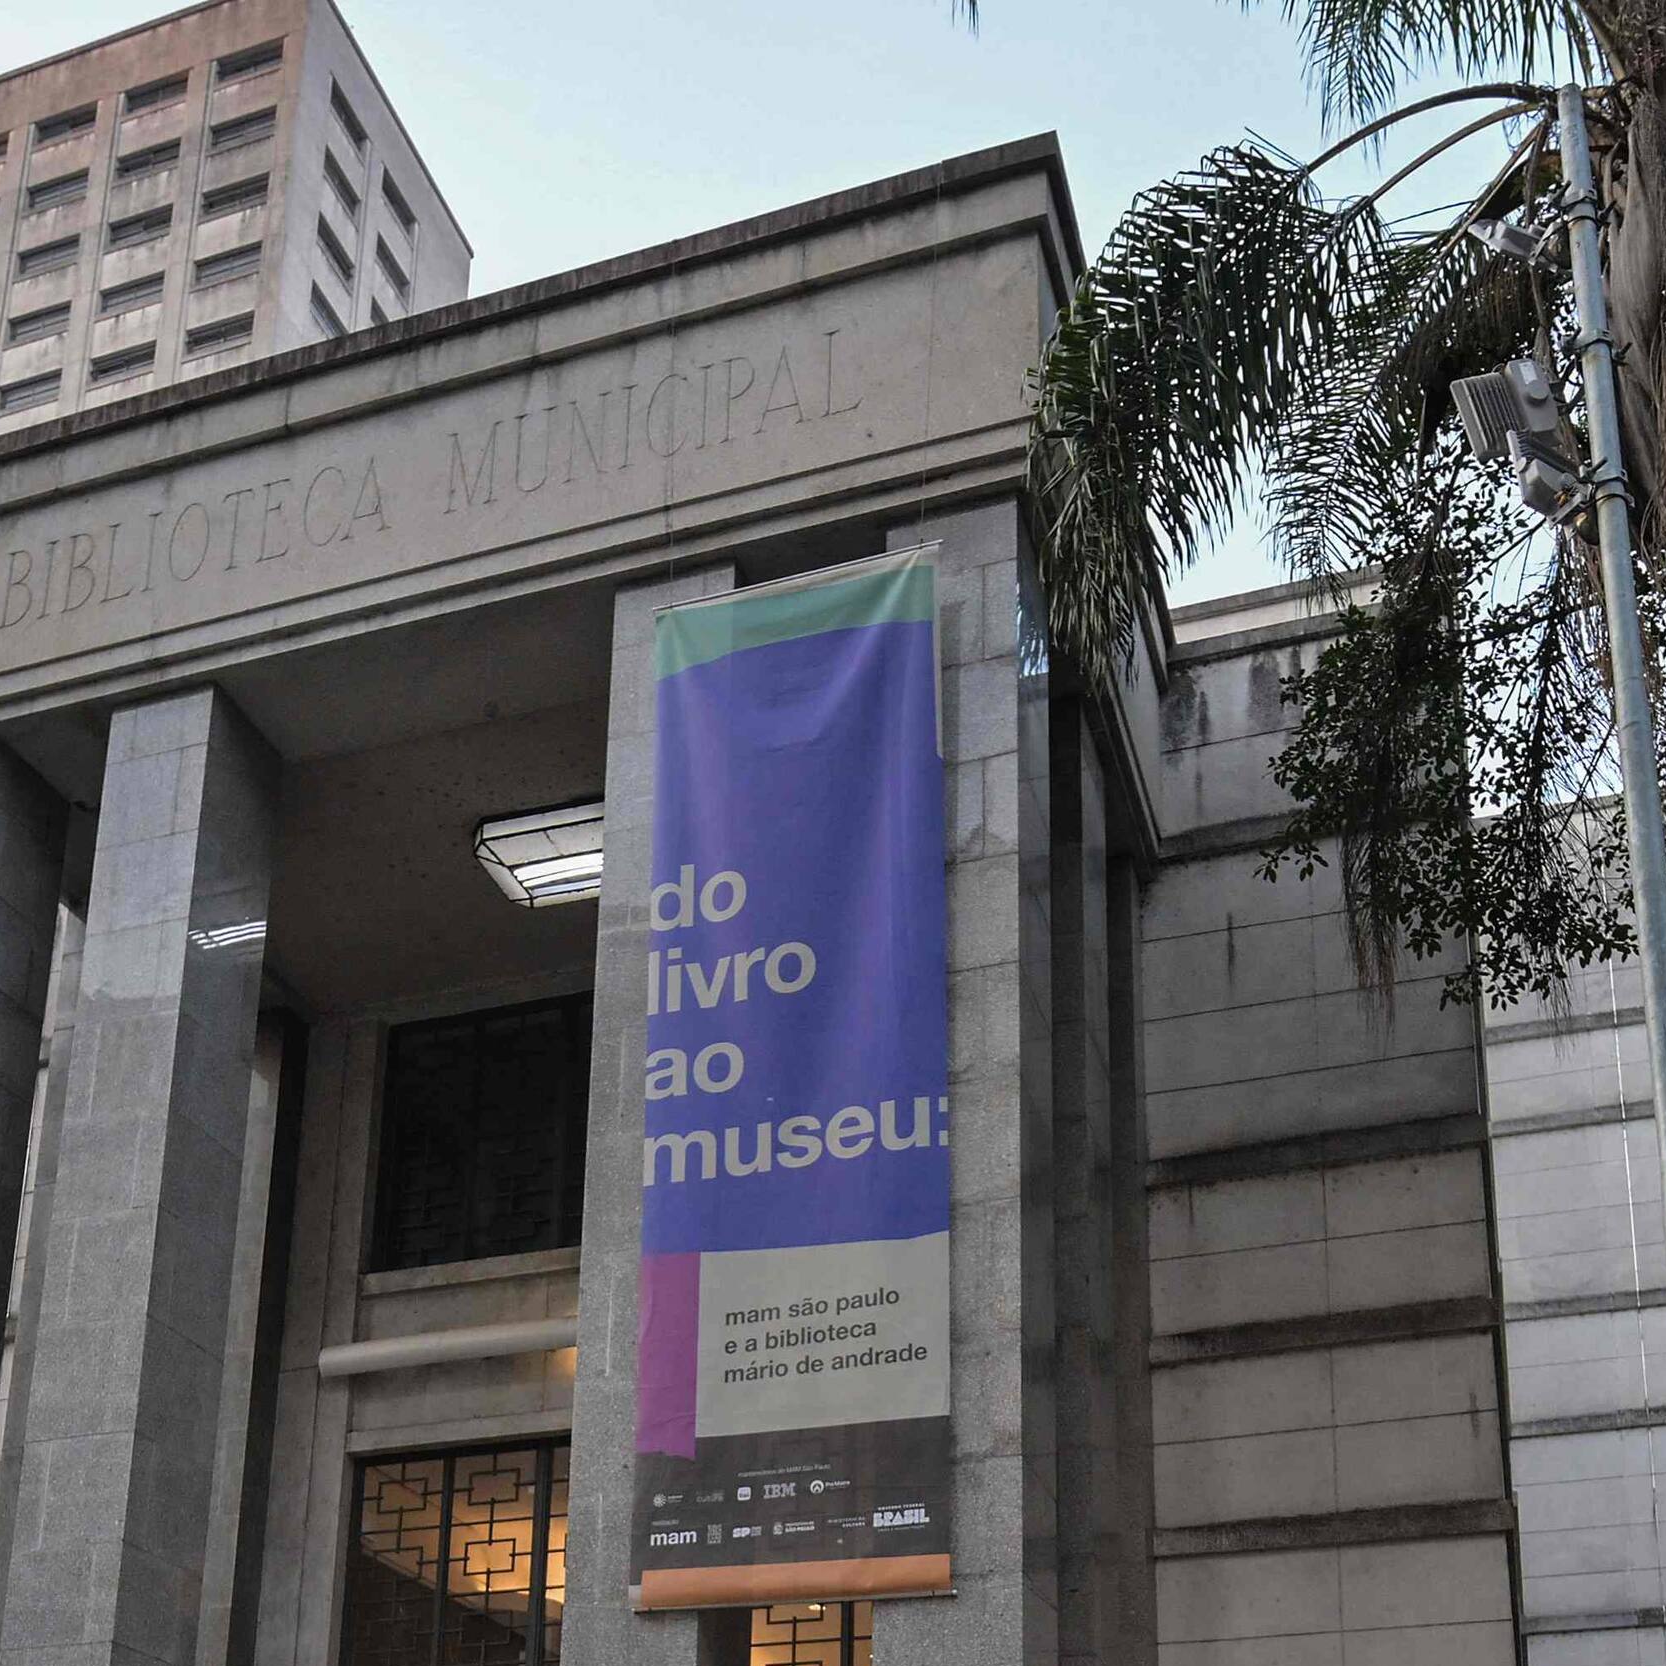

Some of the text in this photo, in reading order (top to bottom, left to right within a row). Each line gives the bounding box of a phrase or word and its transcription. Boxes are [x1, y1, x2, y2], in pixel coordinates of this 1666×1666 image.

[443, 328, 863, 514] MUNICIPAL
[650, 864, 747, 932] do
[647, 942, 816, 1016] livro
[645, 1042, 744, 1100] ao
[643, 1096, 948, 1187] museu:
[725, 1287, 900, 1326] mam são paulo
[724, 1321, 876, 1354] e a biblioteca
[724, 1343, 927, 1383] mário de andrade
[763, 1482, 796, 1499] IBM
[873, 1508, 930, 1527] BRASIL
[650, 1531, 697, 1546] mam
